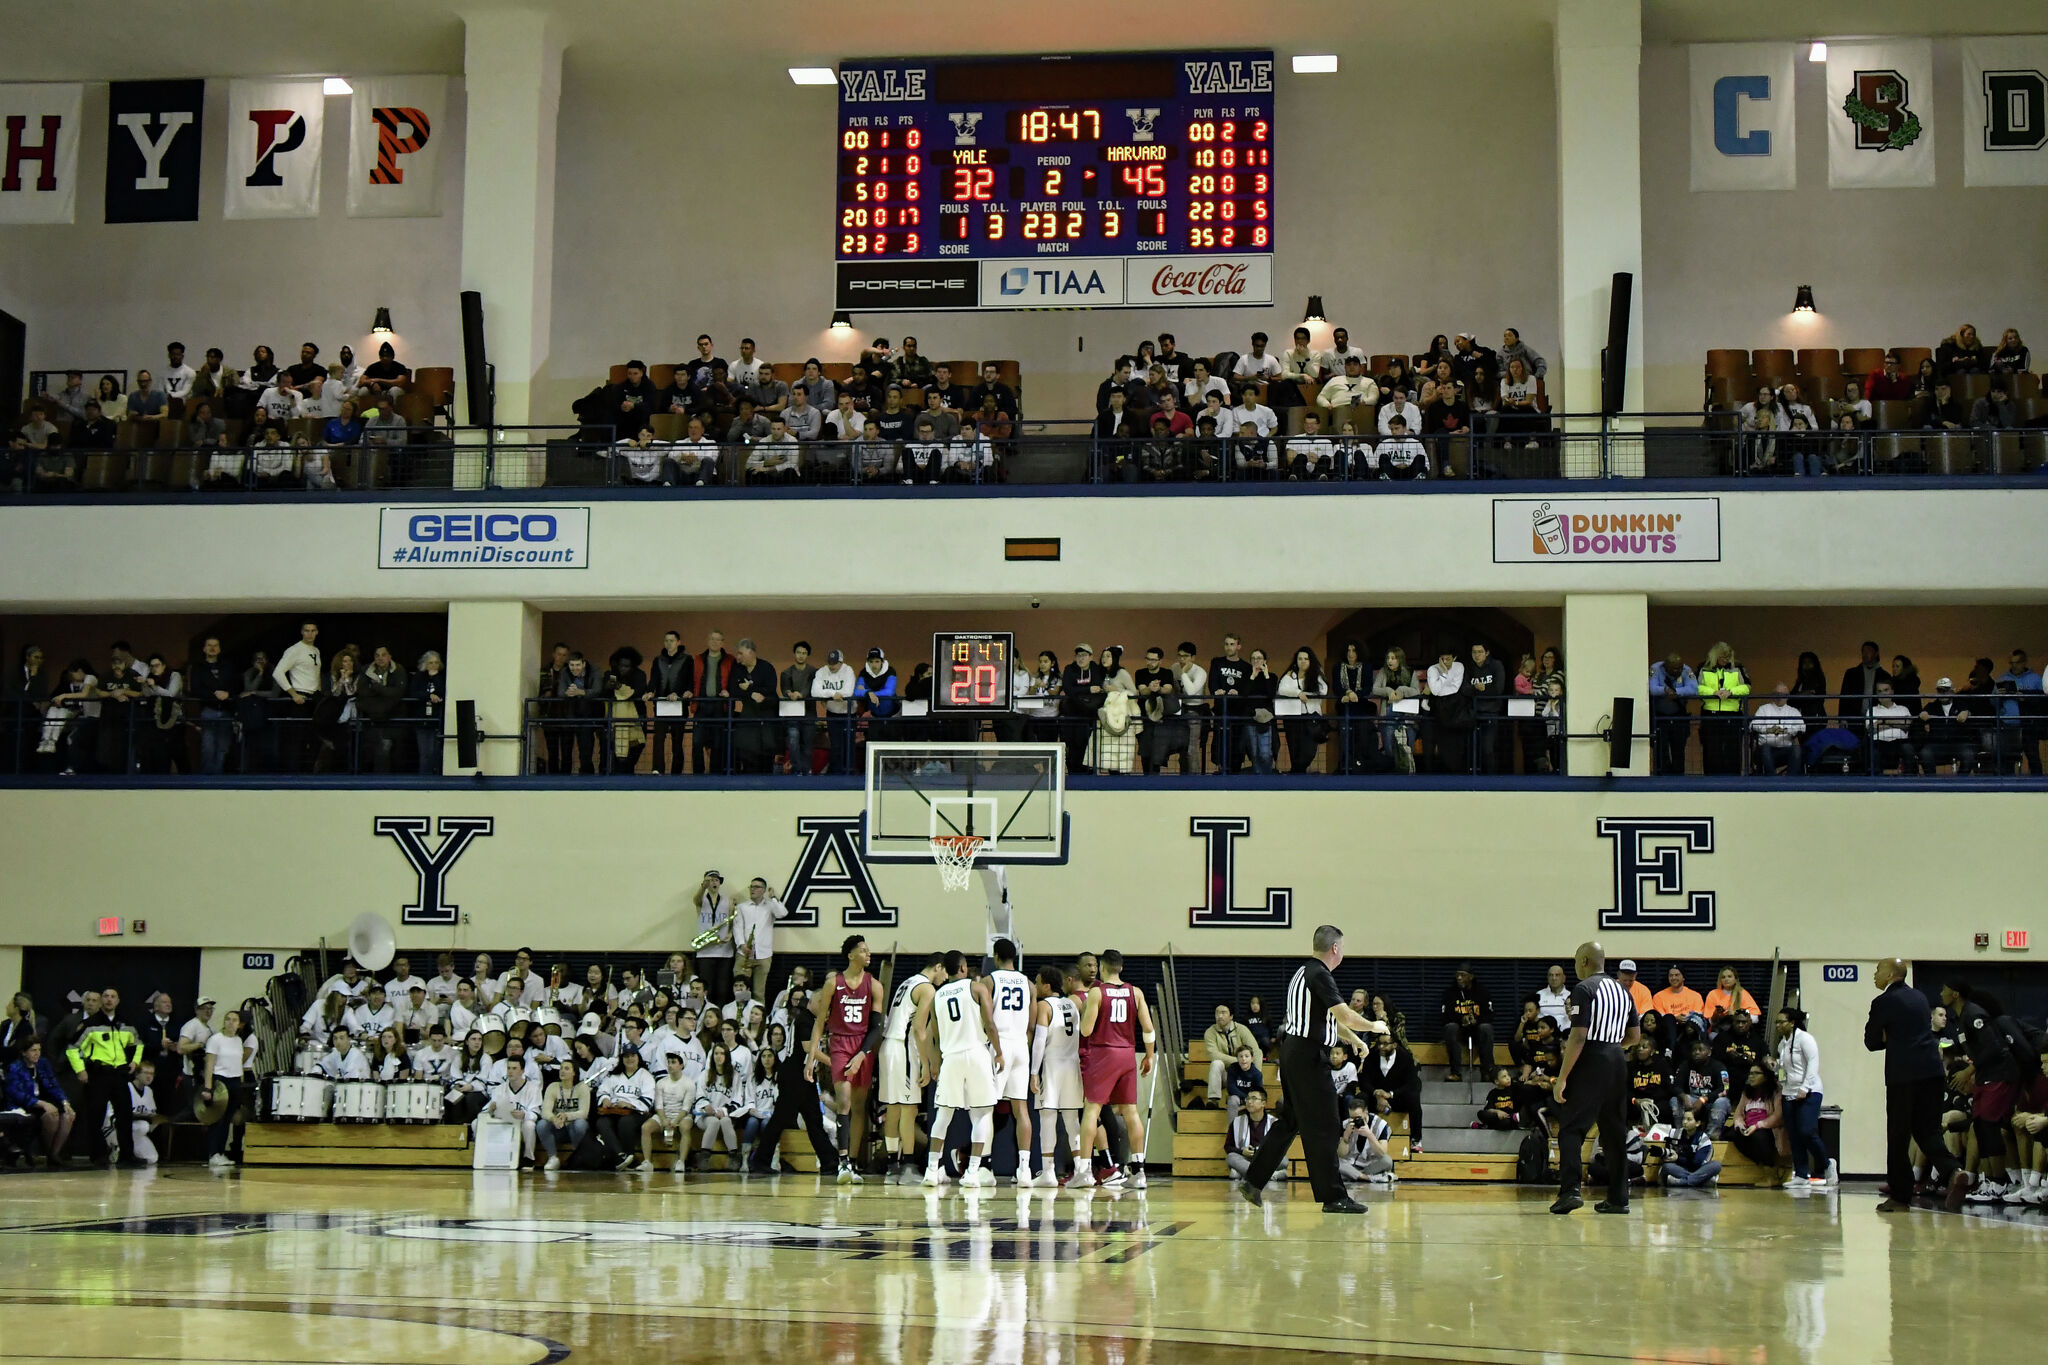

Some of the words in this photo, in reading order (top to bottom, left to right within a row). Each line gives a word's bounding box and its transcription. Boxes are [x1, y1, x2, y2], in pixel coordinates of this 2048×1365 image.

[840, 69, 926, 102] YALE
[1185, 61, 1272, 93] YALE
[849, 116, 868, 126] PLYR
[875, 116, 888, 126] FLS
[899, 115, 913, 125] PTS
[1194, 108, 1213, 118] PLYR
[1222, 108, 1235, 117] FLS
[1245, 107, 1259, 117] PTS
[1714, 75, 1772, 156] C
[1854, 70, 1910, 151] B
[1983, 70, 2048, 151] D
[1021, 110, 1100, 142] 18:47
[1189, 123, 1214, 142] 00
[1220, 121, 1235, 142] 2
[1253, 120, 1268, 141] 2
[246, 110, 306, 186] P
[369, 108, 431, 184] P
[844, 130, 869, 150] 00
[881, 131, 889, 148] 1
[906, 129, 921, 149] 0
[2, 115, 62, 191] H
[118, 112, 193, 190] Y
[953, 149, 987, 164] YALE
[1037, 156, 1071, 166] PERIOD
[1108, 146, 1166, 161] HARVARD
[1196, 149, 1214, 167] 10
[1220, 148, 1235, 168] 0
[1247, 149, 1268, 167] 11
[856, 157, 869, 175] 2
[880, 157, 889, 174] 1
[906, 155, 920, 175] 0
[856, 182, 868, 201] 5
[874, 181, 888, 201] 0
[906, 181, 920, 201] 6
[954, 168, 995, 200] 32
[1045, 170, 1061, 195] 2
[1123, 165, 1165, 197] 45
[1189, 175, 1214, 194] 20
[1220, 174, 1235, 194] 0
[1255, 173, 1268, 194] 3
[939, 203, 970, 214] FOULS
[982, 203, 1009, 213] T.O.L.
[1020, 202, 1056, 212] PLAYER
[1062, 201, 1086, 211] FOUL
[1098, 200, 1124, 210] T.O.L.
[1137, 200, 1167, 210] FOULS
[1189, 201, 1214, 220] 22
[1220, 200, 1235, 221] 0
[1254, 200, 1268, 220] 5
[842, 208, 868, 228] 20
[874, 207, 888, 227] 0
[899, 207, 920, 226] 17
[959, 216, 967, 239] 1
[989, 214, 1003, 239] 3
[1024, 213, 1057, 238] 23
[1066, 213, 1082, 237] 2
[1104, 212, 1119, 237] 3
[1157, 212, 1165, 235] 1
[842, 234, 867, 254] 23
[873, 233, 887, 254] 2
[907, 233, 920, 253] 3
[1137, 241, 1167, 251] SCORE
[1190, 228, 1214, 247] 35
[1220, 226, 1235, 247] 2
[1253, 226, 1268, 247] 8
[939, 245, 970, 255] SCORE
[1037, 242, 1069, 253] MATCH
[850, 279, 966, 290] PORSCHE
[1033, 269, 1105, 295] TIAA
[1152, 263, 1249, 296] Coca-Cola
[168, 378, 181, 392] Y
[409, 515, 557, 542] GEICO
[1573, 514, 1682, 533] DUNKIN'
[393, 546, 574, 562] #AlumniDiscount
[1573, 535, 1676, 554] DONUTS
[1221, 667, 1242, 678] YALE
[951, 665, 996, 703] 20
[100, 917, 118, 934] EXIT
[2007, 931, 2027, 947] EXIT
[247, 956, 270, 967] 001
[1828, 968, 1854, 979] 002
[947, 997, 961, 1022] 0
[1001, 987, 1023, 1011] 23
[843, 1005, 862, 1023] 35
[1110, 999, 1127, 1023] 10
[1064, 1012, 1073, 1036] 5
[429, 1059, 445, 1075] Y
